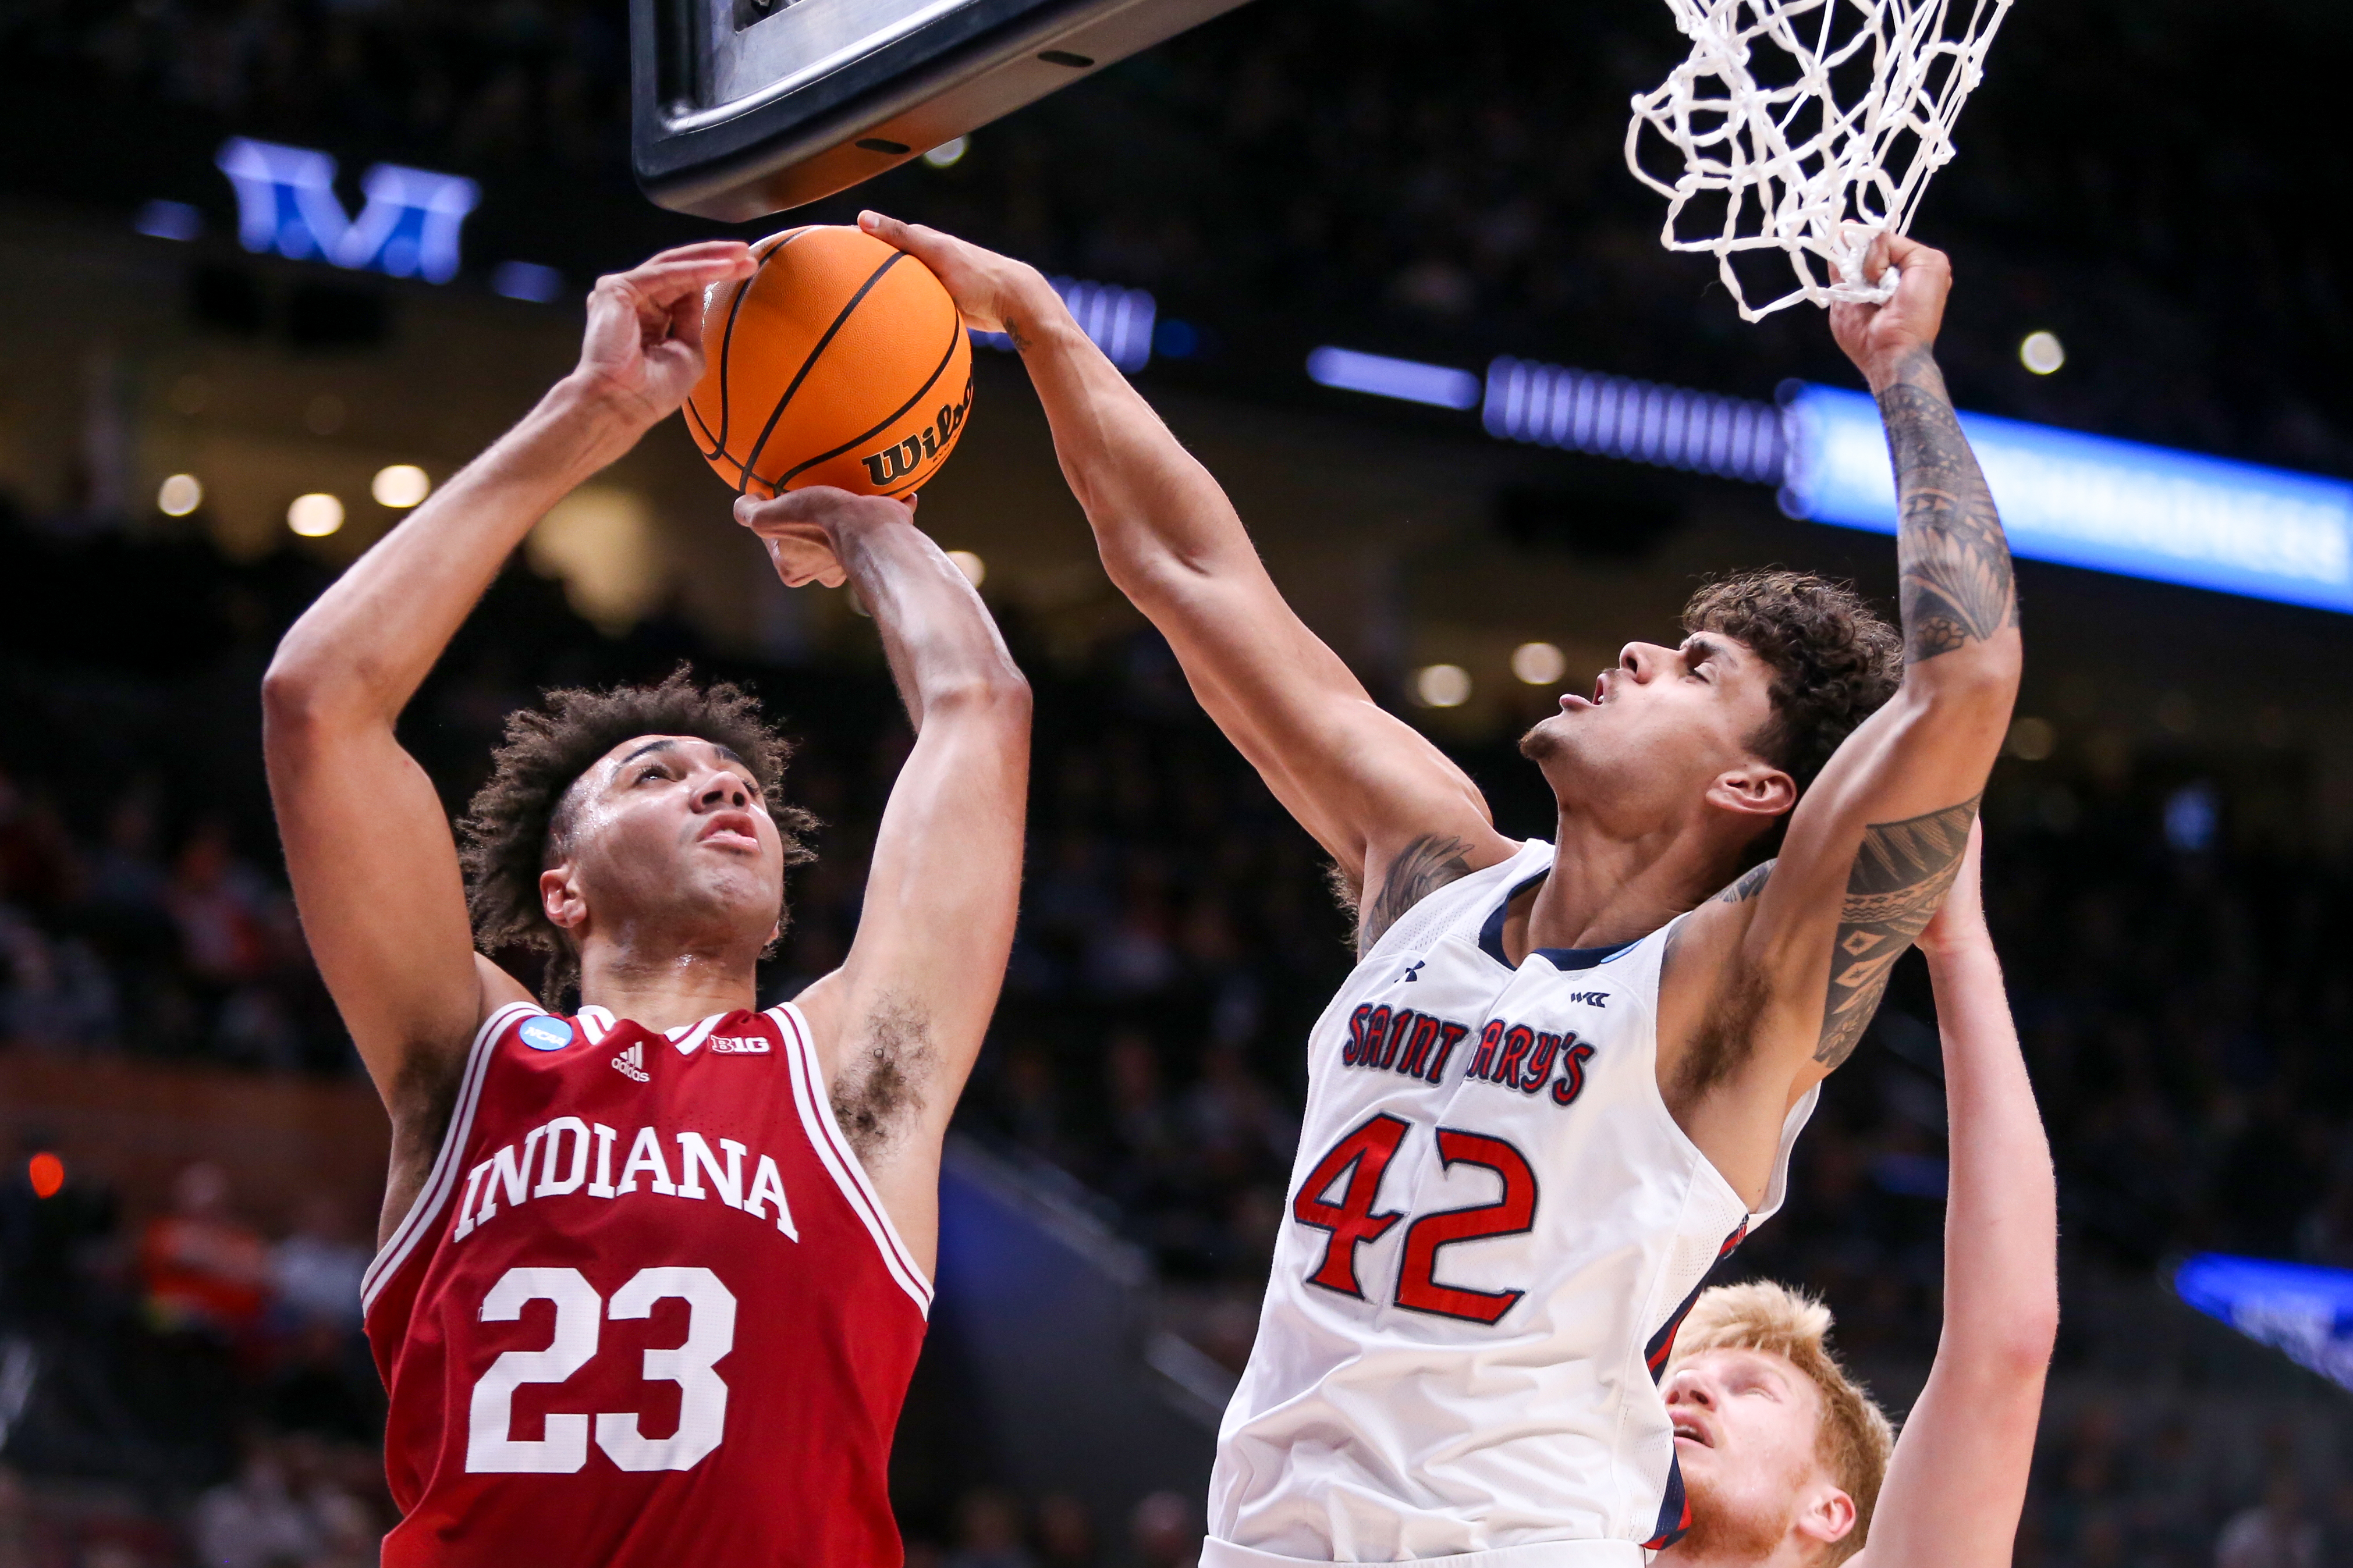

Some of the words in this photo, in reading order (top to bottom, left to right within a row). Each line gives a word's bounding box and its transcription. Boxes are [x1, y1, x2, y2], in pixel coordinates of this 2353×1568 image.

[861, 361, 973, 487] Wilso
[524, 1026, 566, 1047] NCAA
[612, 1058, 651, 1083] adidas
[1342, 1002, 1470, 1084] SAINT
[1465, 1018, 1596, 1107] ARY'S
[454, 1116, 799, 1243] INDIANA
[1293, 1112, 1538, 1326] 42
[465, 1267, 737, 1473] 23
